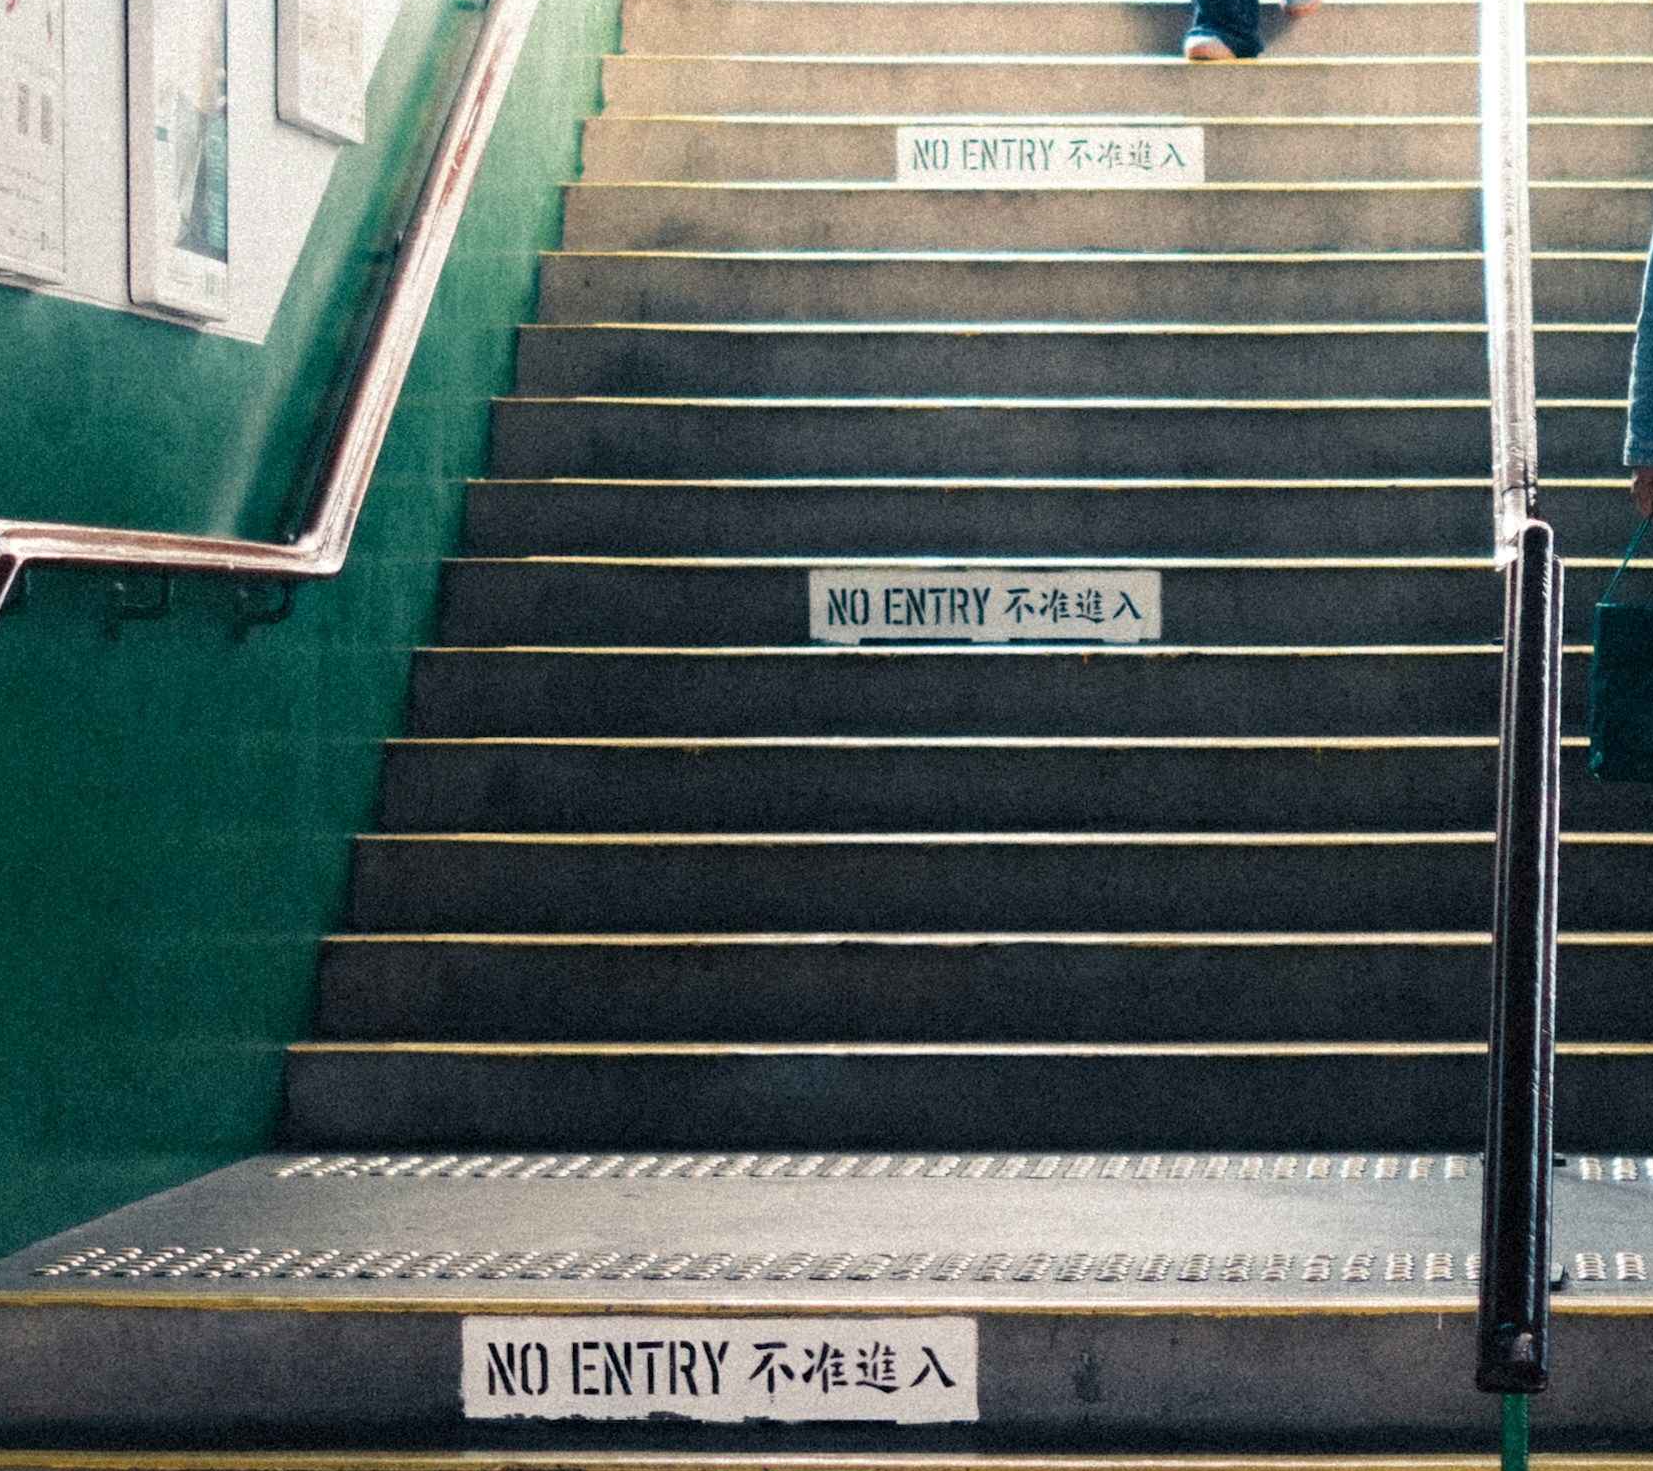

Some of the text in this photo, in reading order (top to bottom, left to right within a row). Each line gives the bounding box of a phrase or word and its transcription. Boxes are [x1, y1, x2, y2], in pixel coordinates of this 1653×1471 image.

[913, 138, 948, 171] NO
[962, 138, 1054, 171] ENTRY
[827, 587, 1143, 626] NO ENTRY 不准進入
[487, 1341, 957, 1396] NO ENTRY 不准進入
